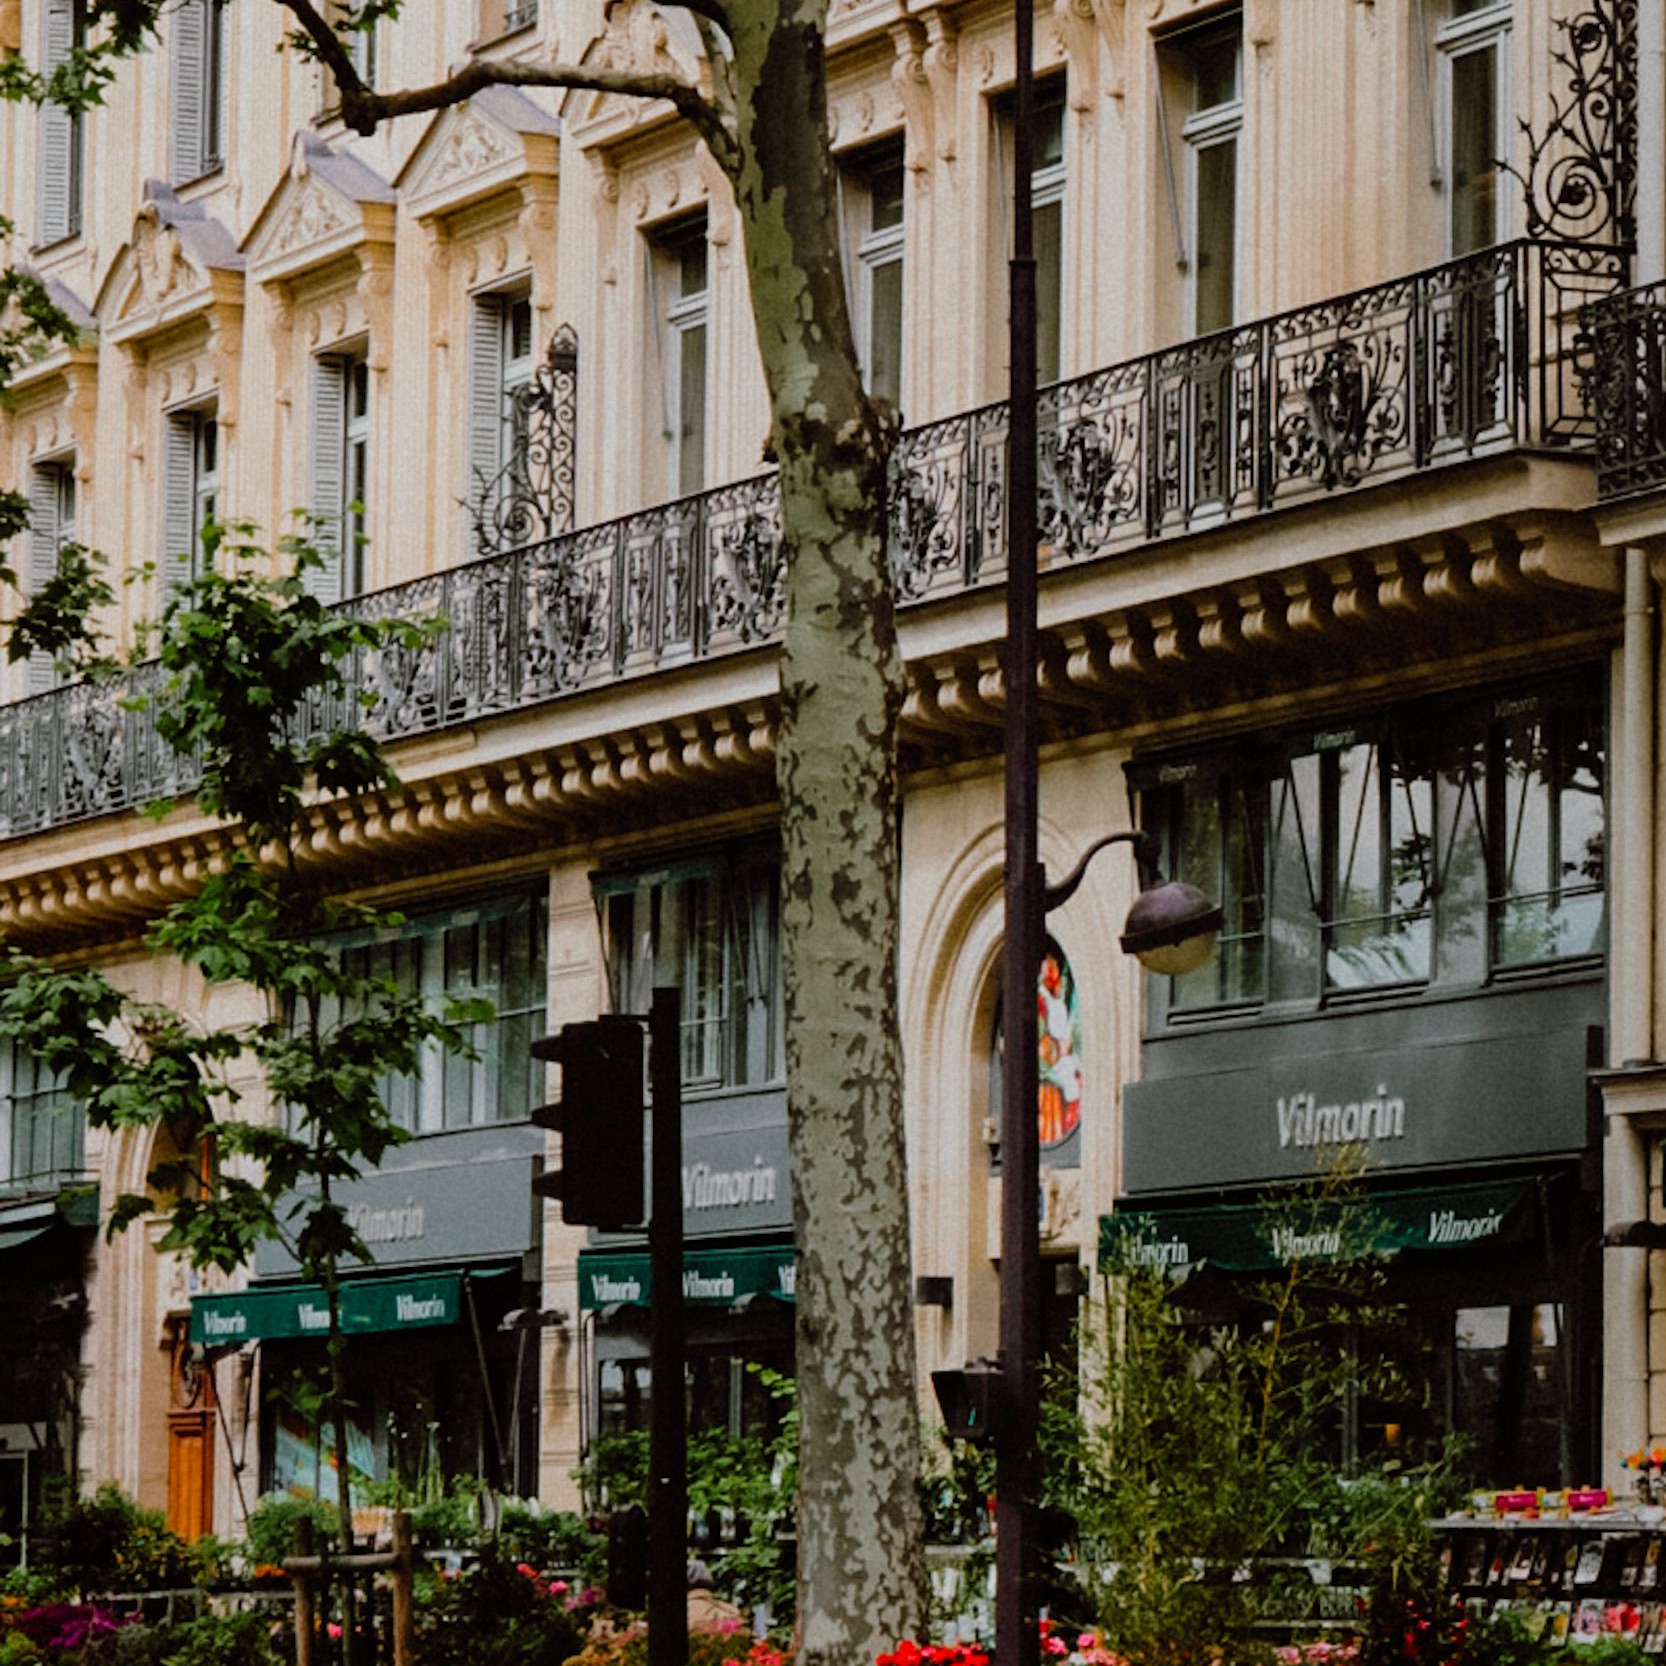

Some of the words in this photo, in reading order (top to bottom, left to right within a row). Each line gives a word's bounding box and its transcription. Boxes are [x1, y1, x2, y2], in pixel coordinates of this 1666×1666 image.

[1277, 1083, 1404, 1149] Vilmorin
[591, 1274, 641, 1301] Vilmorin
[396, 1293, 445, 1321] Vilmorin
